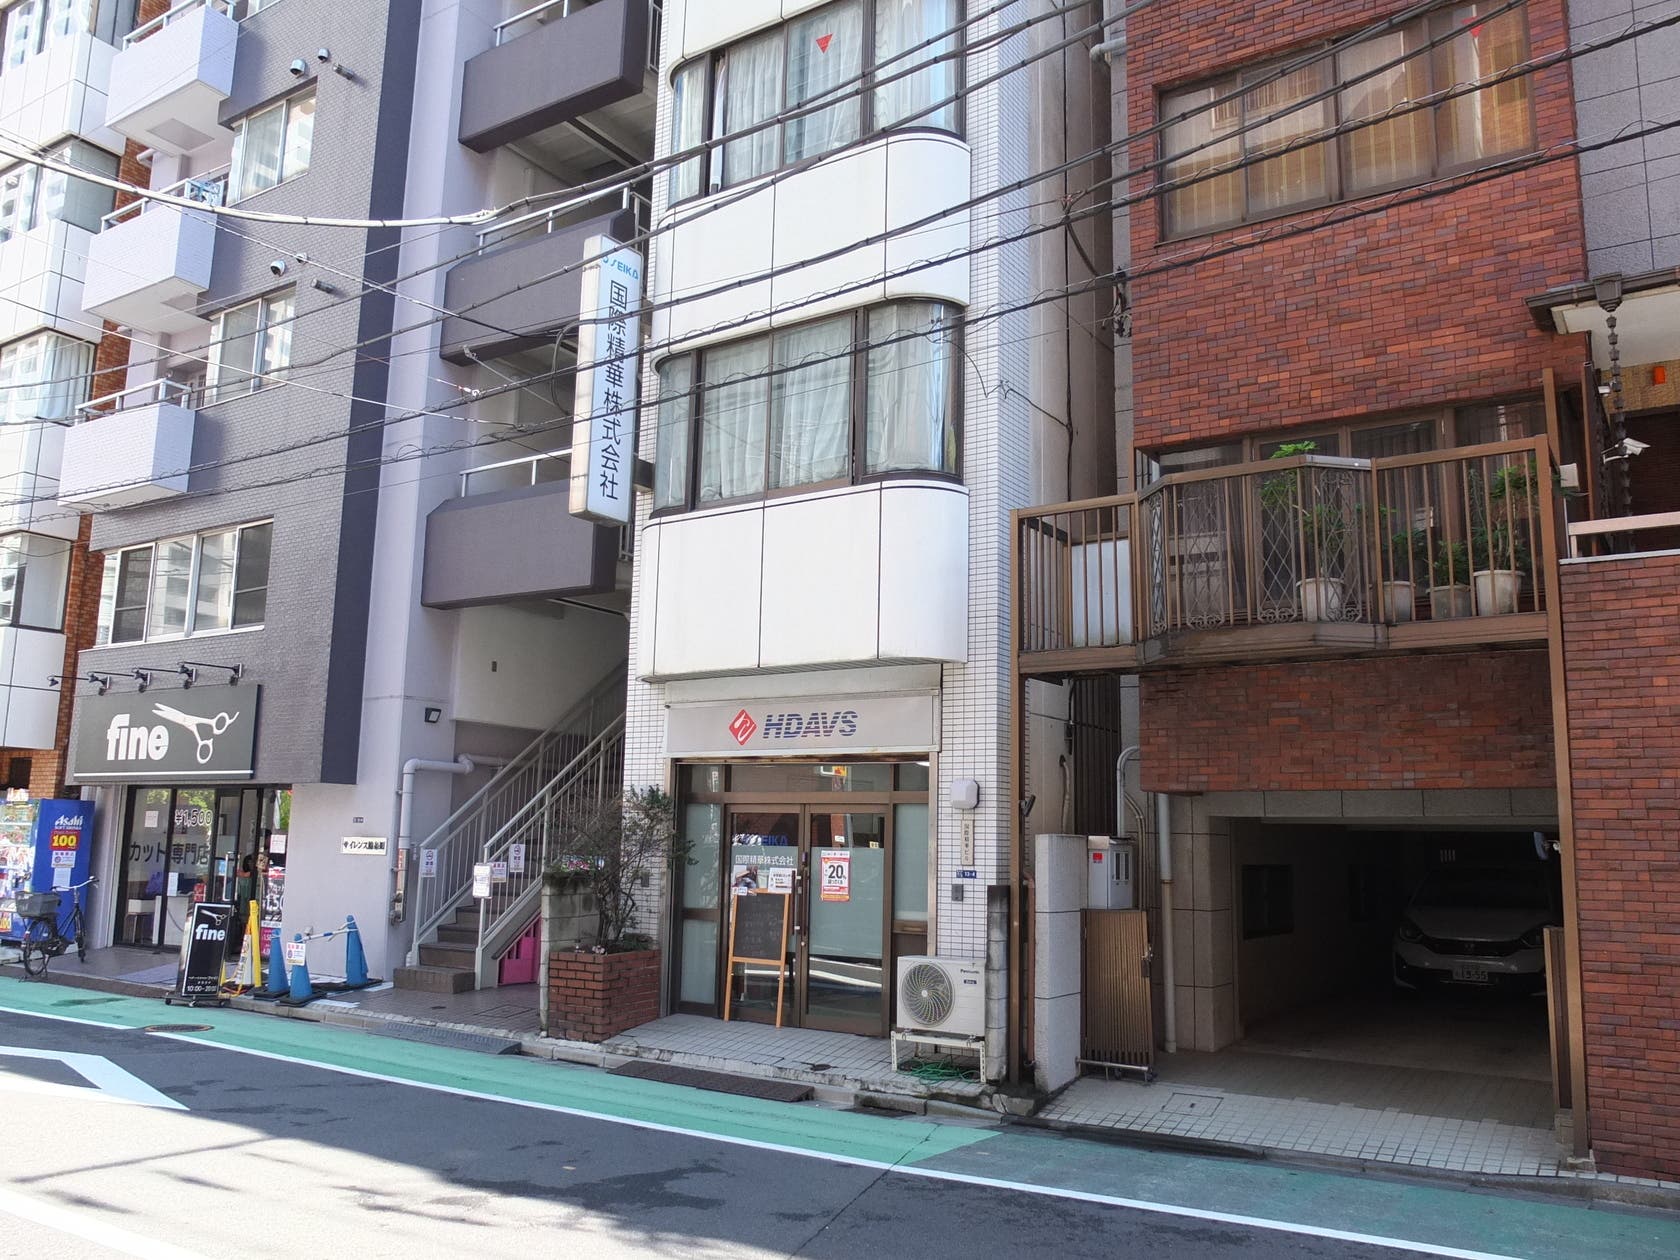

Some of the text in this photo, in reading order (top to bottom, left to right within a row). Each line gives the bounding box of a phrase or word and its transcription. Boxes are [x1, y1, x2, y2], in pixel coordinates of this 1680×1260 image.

[600, 280, 628, 500] 国際精華株式会社
[763, 711, 858, 739] HDAVS
[107, 713, 169, 760] fine
[55, 815, 83, 826] Asahi
[175, 808, 212, 827] ¥1,500
[52, 835, 77, 847] 100
[196, 923, 226, 940] fine
